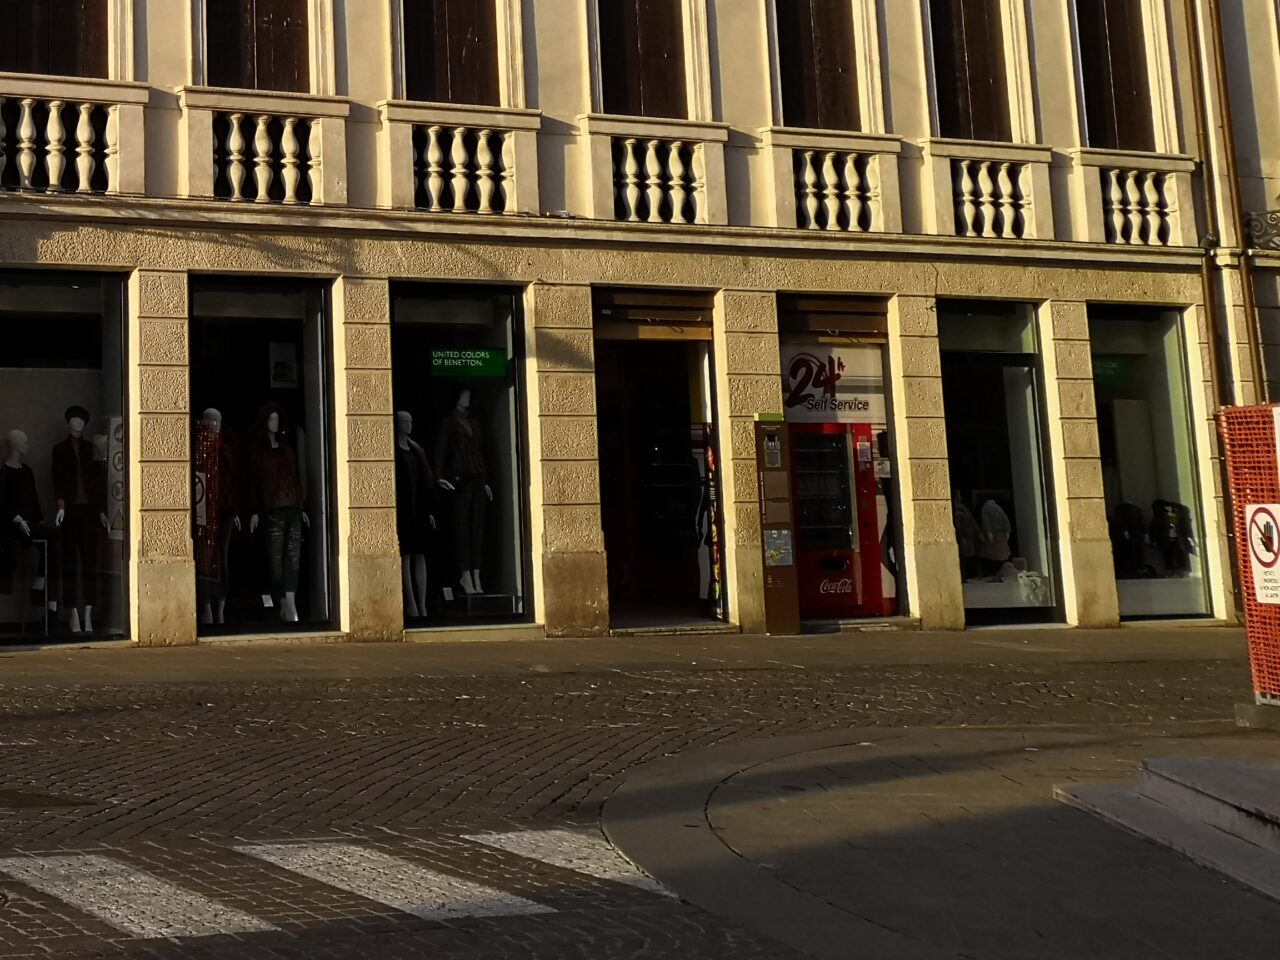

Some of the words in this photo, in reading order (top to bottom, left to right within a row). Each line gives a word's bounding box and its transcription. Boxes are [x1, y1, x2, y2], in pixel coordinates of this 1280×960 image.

[432, 358, 442, 366] OF
[807, 397, 828, 411] Self
[830, 397, 869, 411] Service
